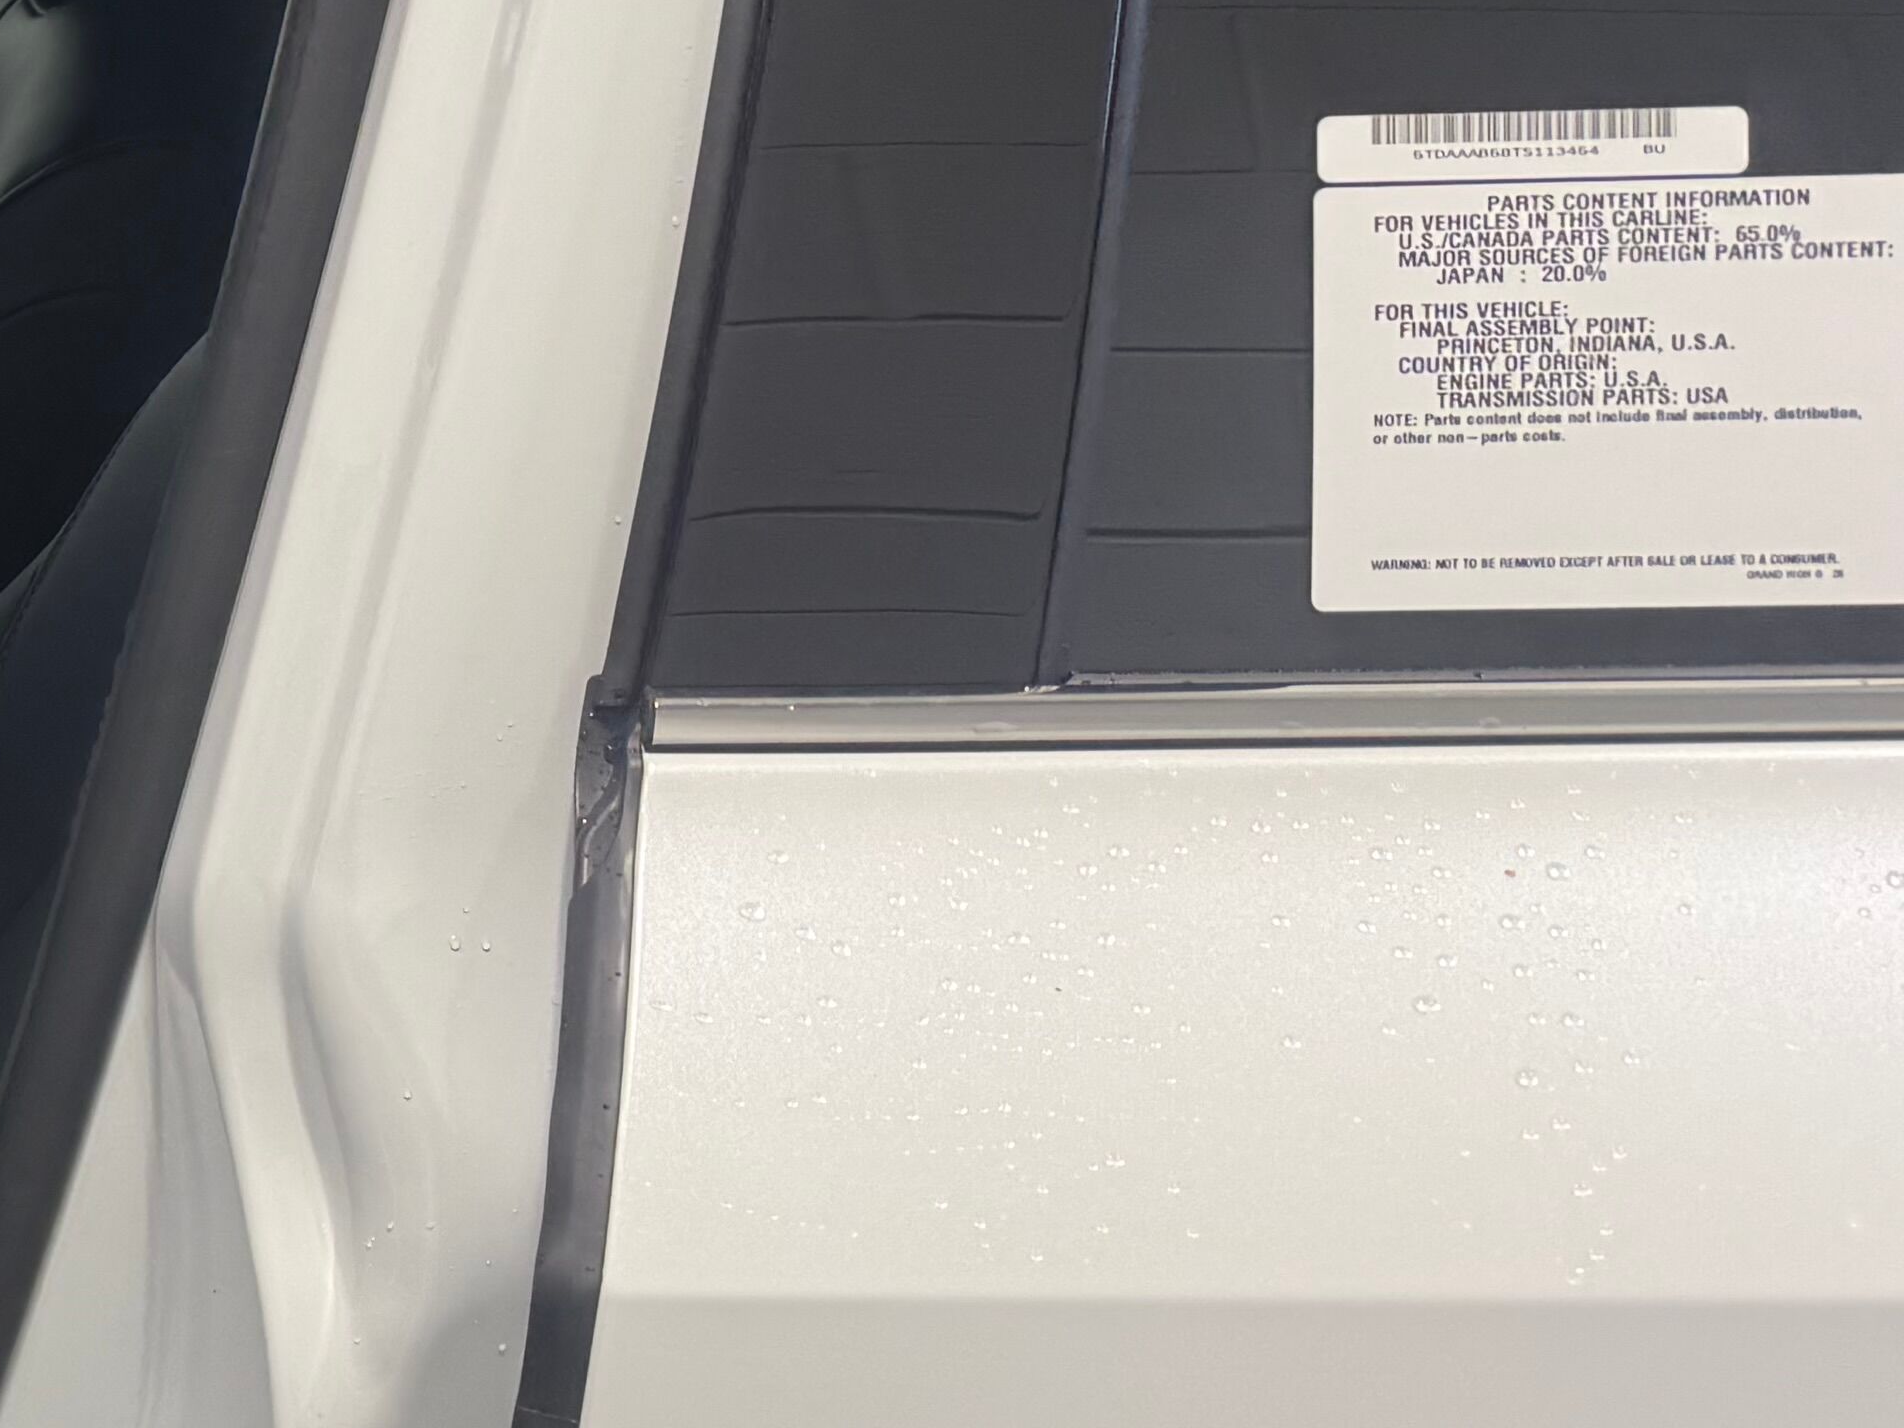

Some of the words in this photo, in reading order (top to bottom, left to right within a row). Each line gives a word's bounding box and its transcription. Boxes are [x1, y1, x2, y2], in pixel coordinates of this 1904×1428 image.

[1487, 195, 1555, 211] PARTS
[1562, 192, 1658, 209] CONTENT
[1665, 189, 1810, 207] INFORMATION
[1373, 215, 1413, 231] FOR
[1420, 213, 1519, 230] VEHICLES
[1527, 213, 1548, 228] IN
[1556, 212, 1604, 228] THIS
[1611, 210, 1708, 227] CARLINE:
[1398, 230, 1534, 248] U.S./CANADA
[1542, 229, 1610, 246] PARTS
[1617, 226, 1720, 245] CONTENT:
[1735, 225, 1801, 242] 65.0%
[1398, 249, 1471, 266] MAJOR
[1478, 247, 1575, 265] SOURCES
[1582, 247, 1609, 263] OF
[1617, 245, 1706, 263] FOREIGN
[1714, 243, 1783, 261] PARTS
[1790, 241, 1894, 260] CONTENT:
[1435, 267, 1504, 285] JAPAN
[1541, 266, 1607, 283] 20.0%
[1374, 304, 1414, 320] FOR
[1420, 303, 1469, 319] THIS
[1476, 301, 1568, 318] VEHICLE:
[1399, 321, 1459, 337] FINAL
[1465, 318, 1578, 336] ASSEMBLY
[1586, 317, 1655, 334] POINT:
[1437, 337, 1561, 354] PRINCETON,
[1569, 335, 1663, 352] INDIANA,
[1671, 334, 1735, 351] U.S.A.
[1398, 356, 1497, 373] COUNTRY
[1504, 355, 1531, 371] OF
[1538, 354, 1617, 371] ORIGIN:
[1436, 374, 1512, 391] ENGINE
[1520, 372, 1595, 390] PARTS:
[1603, 371, 1668, 388] U.S.A.
[1436, 390, 1594, 409] TRANSMISSION
[1602, 389, 1678, 406] PARTS:
[1686, 388, 1729, 405] USA
[1466, 411, 1522, 427] content
[1595, 409, 1651, 425] include
